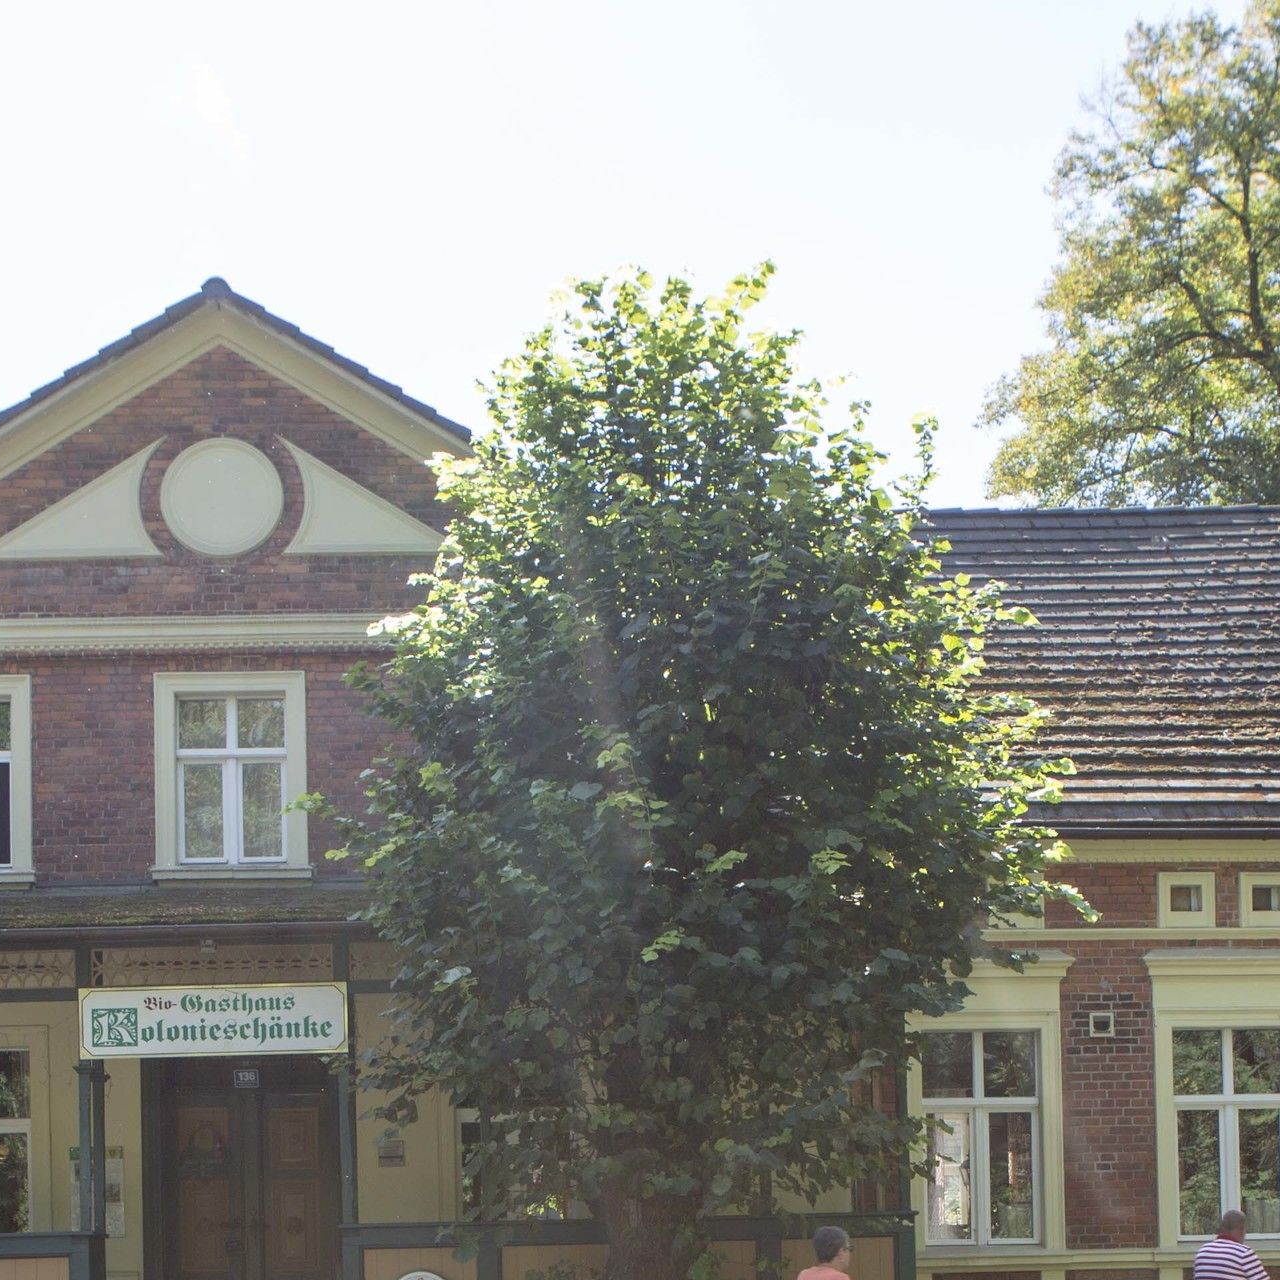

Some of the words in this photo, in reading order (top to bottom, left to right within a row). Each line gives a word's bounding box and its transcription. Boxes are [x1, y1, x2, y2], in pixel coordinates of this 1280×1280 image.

[143, 995, 177, 1011] Bio-
[180, 992, 296, 1016] Gasthaus
[92, 1008, 334, 1047] Kolonieschänke
